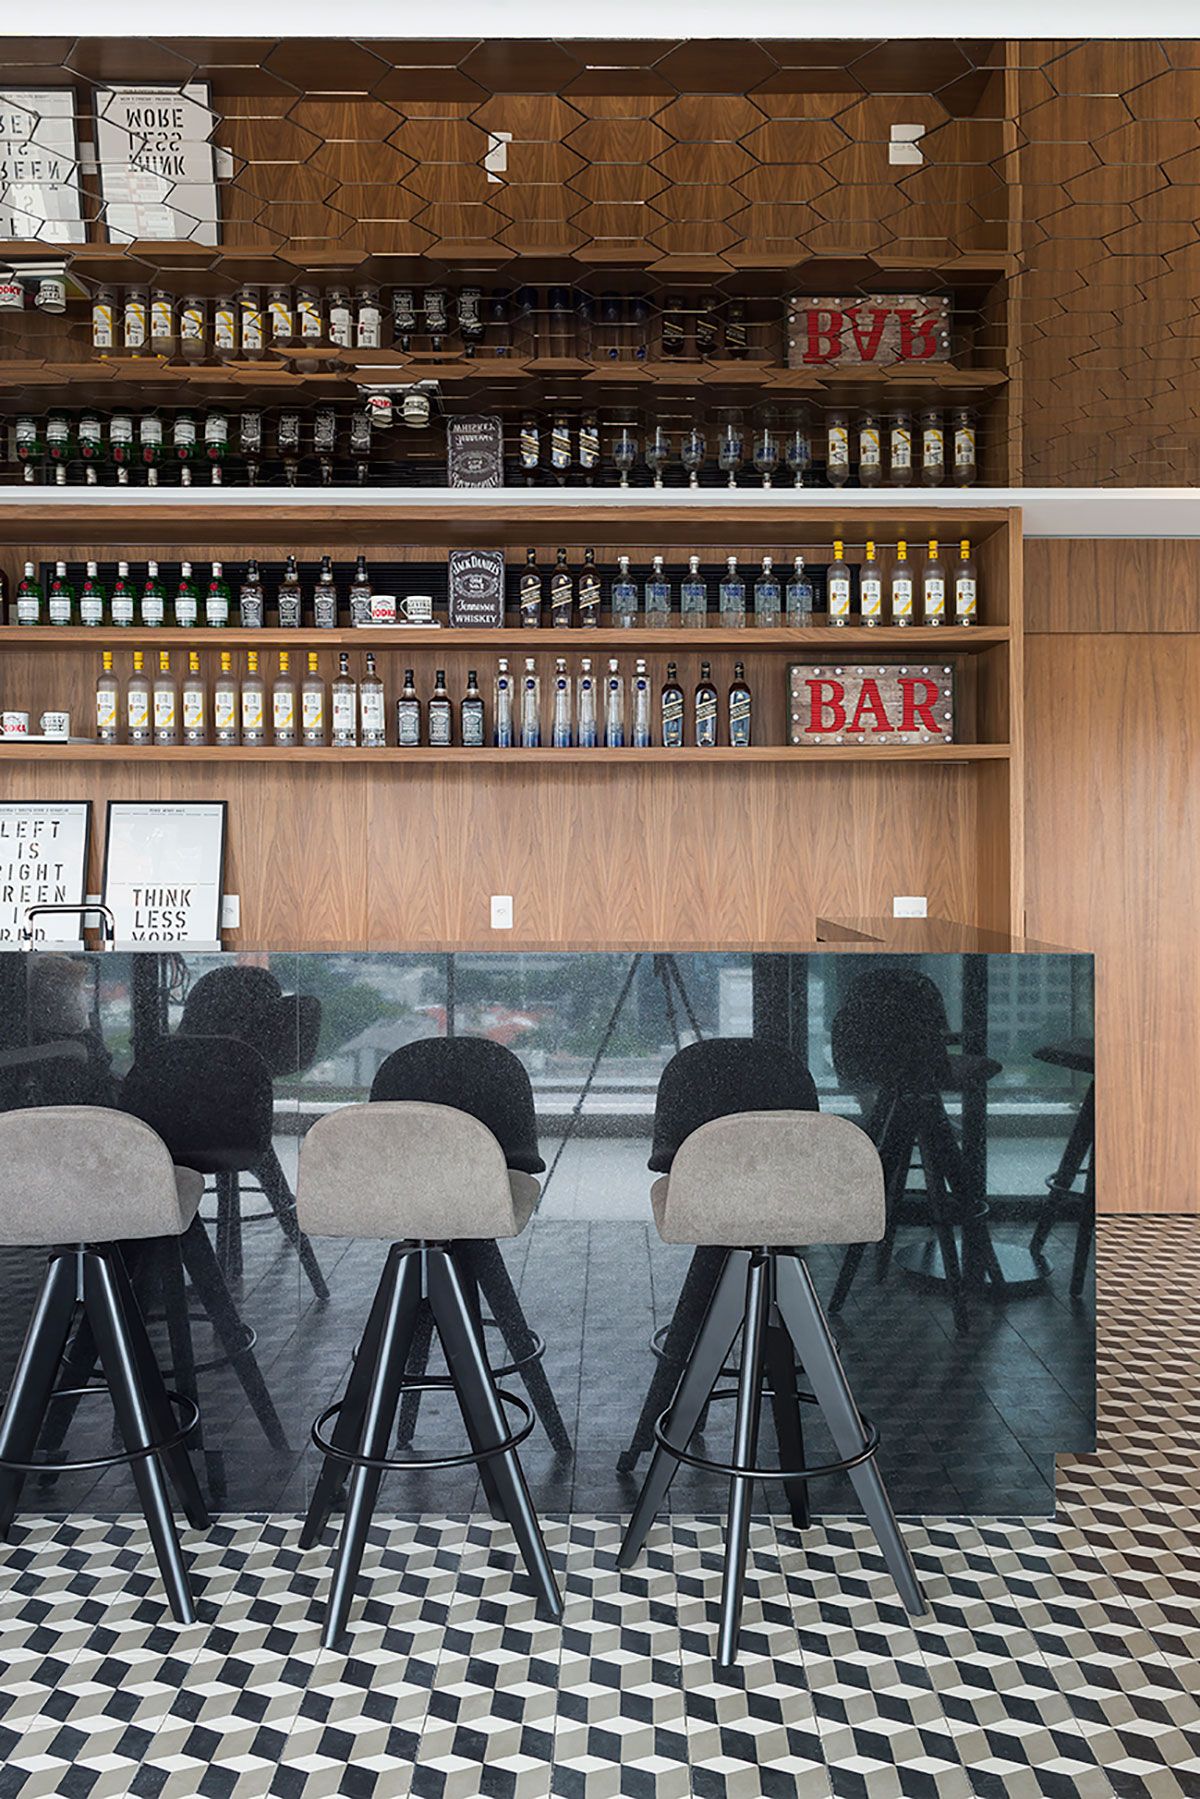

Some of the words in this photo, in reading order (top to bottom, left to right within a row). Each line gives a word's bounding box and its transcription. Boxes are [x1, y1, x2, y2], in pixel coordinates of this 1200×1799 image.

[452, 558, 471, 575] JACK
[455, 614, 497, 623] WHISKEY
[804, 678, 942, 733] BAR
[1, 821, 60, 838] LEFT
[18, 842, 39, 859] IS
[0, 864, 63, 881] IGHT
[132, 889, 192, 907] THINK
[135, 910, 187, 928] LESS
